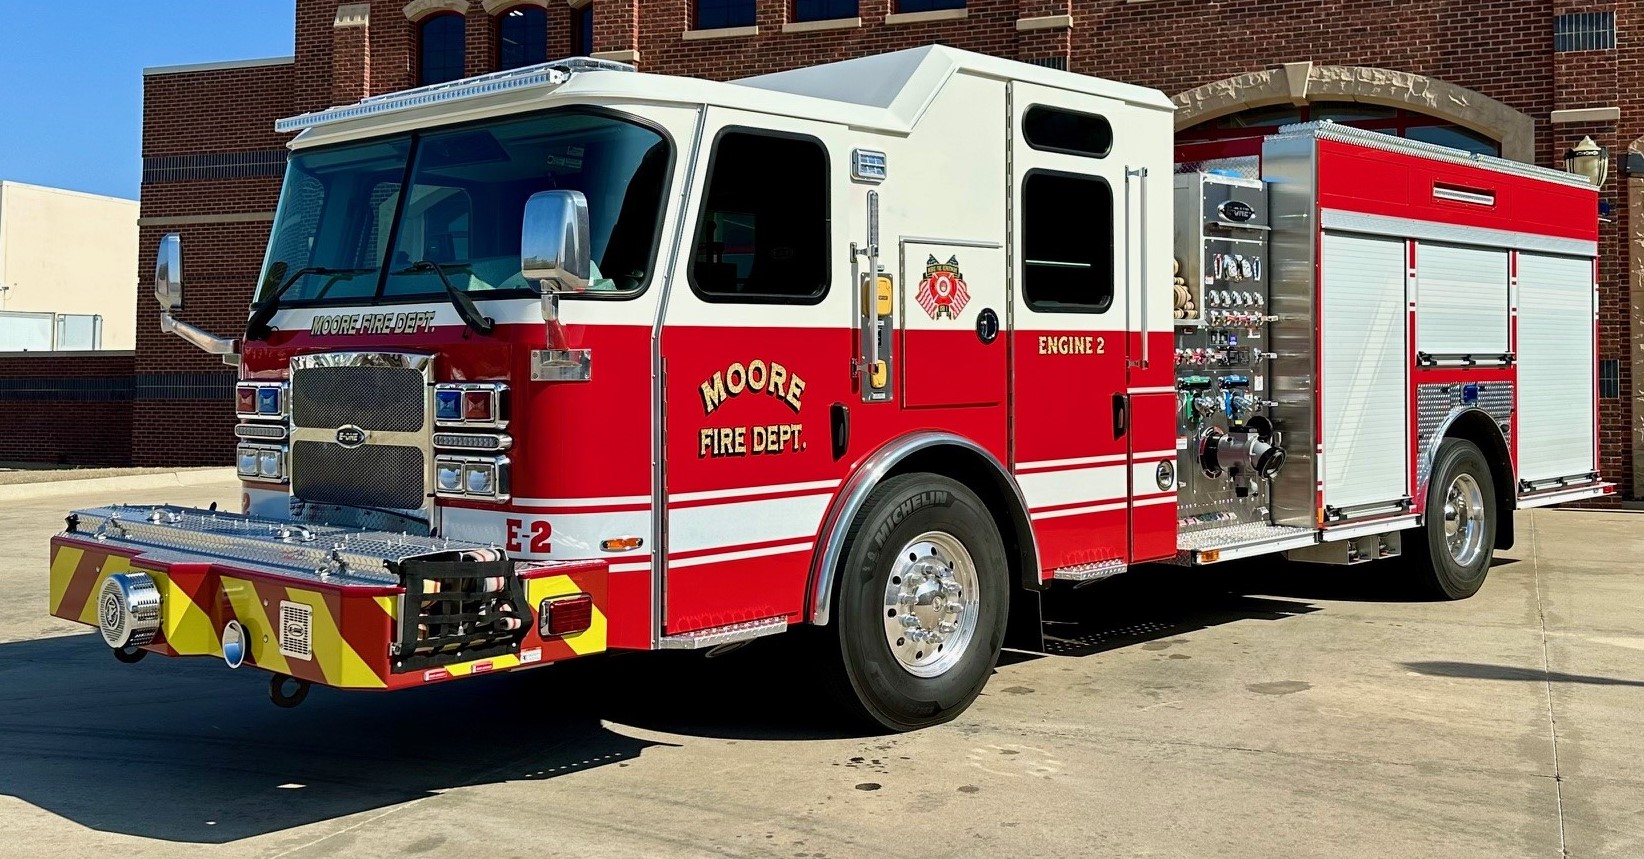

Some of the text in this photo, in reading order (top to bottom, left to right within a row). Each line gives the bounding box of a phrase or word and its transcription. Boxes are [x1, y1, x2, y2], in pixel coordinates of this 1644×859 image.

[310, 311, 436, 335] MOORE FIRE DEPT.
[1038, 335, 1105, 355] ENGINE 2
[698, 359, 806, 416] MOORE
[698, 423, 807, 458] FIRE DEPT.
[506, 518, 552, 553] E-2
[874, 491, 948, 549] MICHELIN
